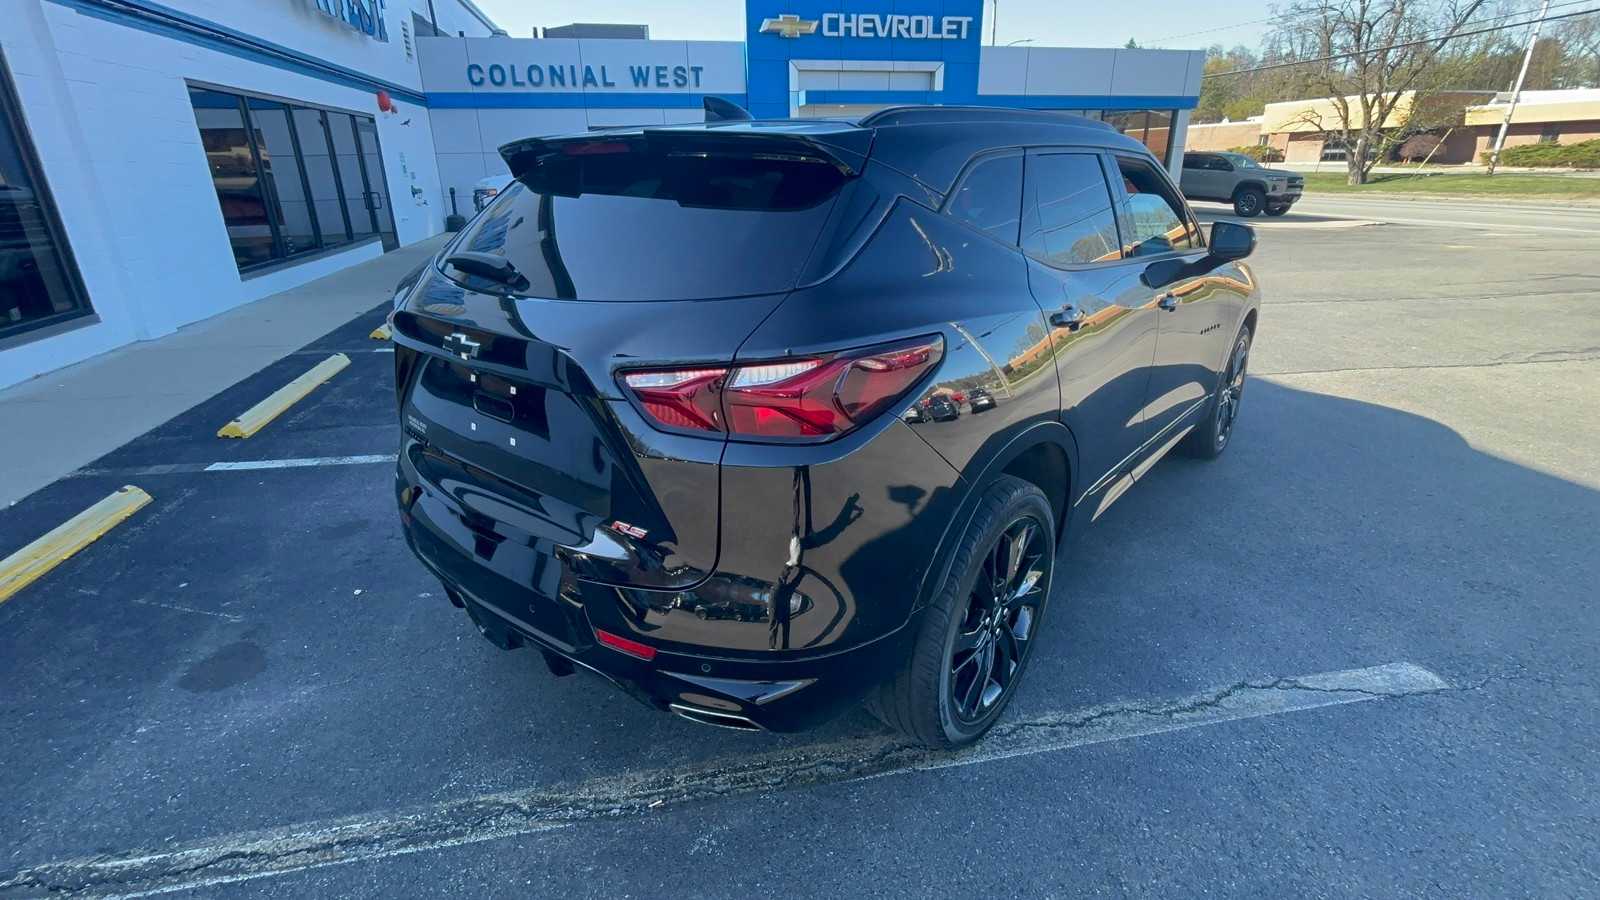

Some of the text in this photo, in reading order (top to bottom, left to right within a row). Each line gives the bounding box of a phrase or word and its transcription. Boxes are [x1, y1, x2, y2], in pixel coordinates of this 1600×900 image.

[822, 13, 973, 39] CHEVROLET
[467, 64, 704, 88] COLONIAL WEST
[611, 520, 648, 539] RS
